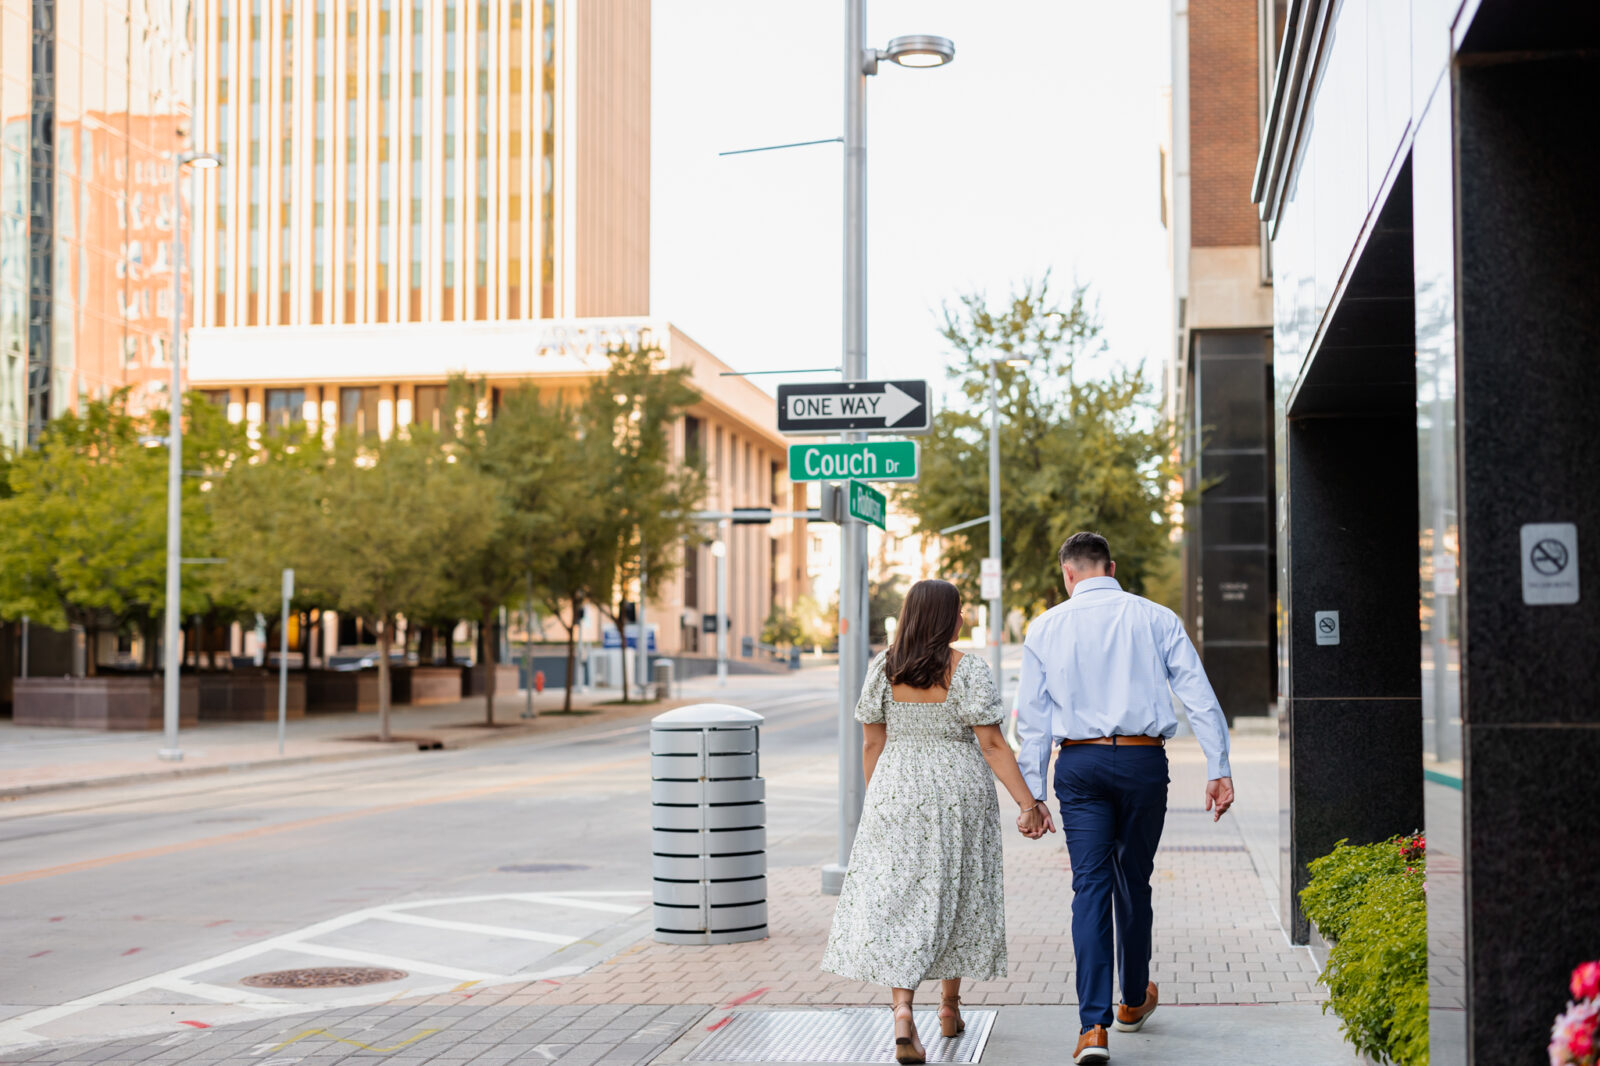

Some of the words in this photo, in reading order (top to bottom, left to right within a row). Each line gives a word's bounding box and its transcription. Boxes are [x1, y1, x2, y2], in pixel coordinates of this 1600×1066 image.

[793, 398, 832, 416] ONE
[840, 396, 881, 415] WAY
[805, 448, 877, 476] Couch
[885, 459, 900, 474] Dr
